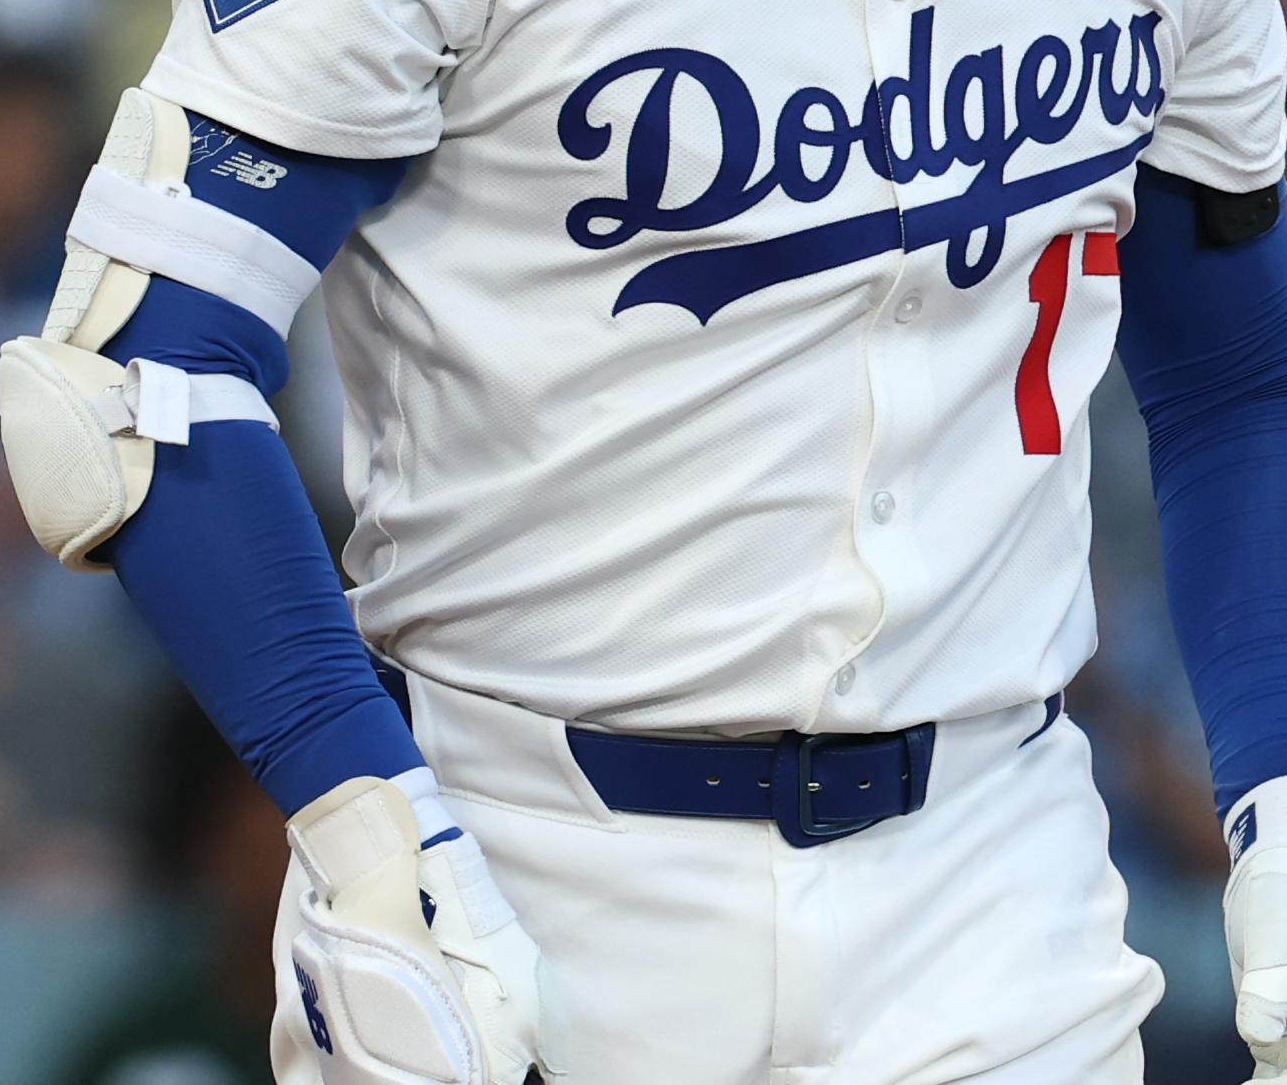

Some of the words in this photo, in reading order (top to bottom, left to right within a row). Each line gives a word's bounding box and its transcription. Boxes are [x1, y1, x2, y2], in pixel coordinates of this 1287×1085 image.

[210, 151, 289, 189] NB
[557, 4, 1166, 290] Dodgers
[1015, 232, 1121, 455] 1
